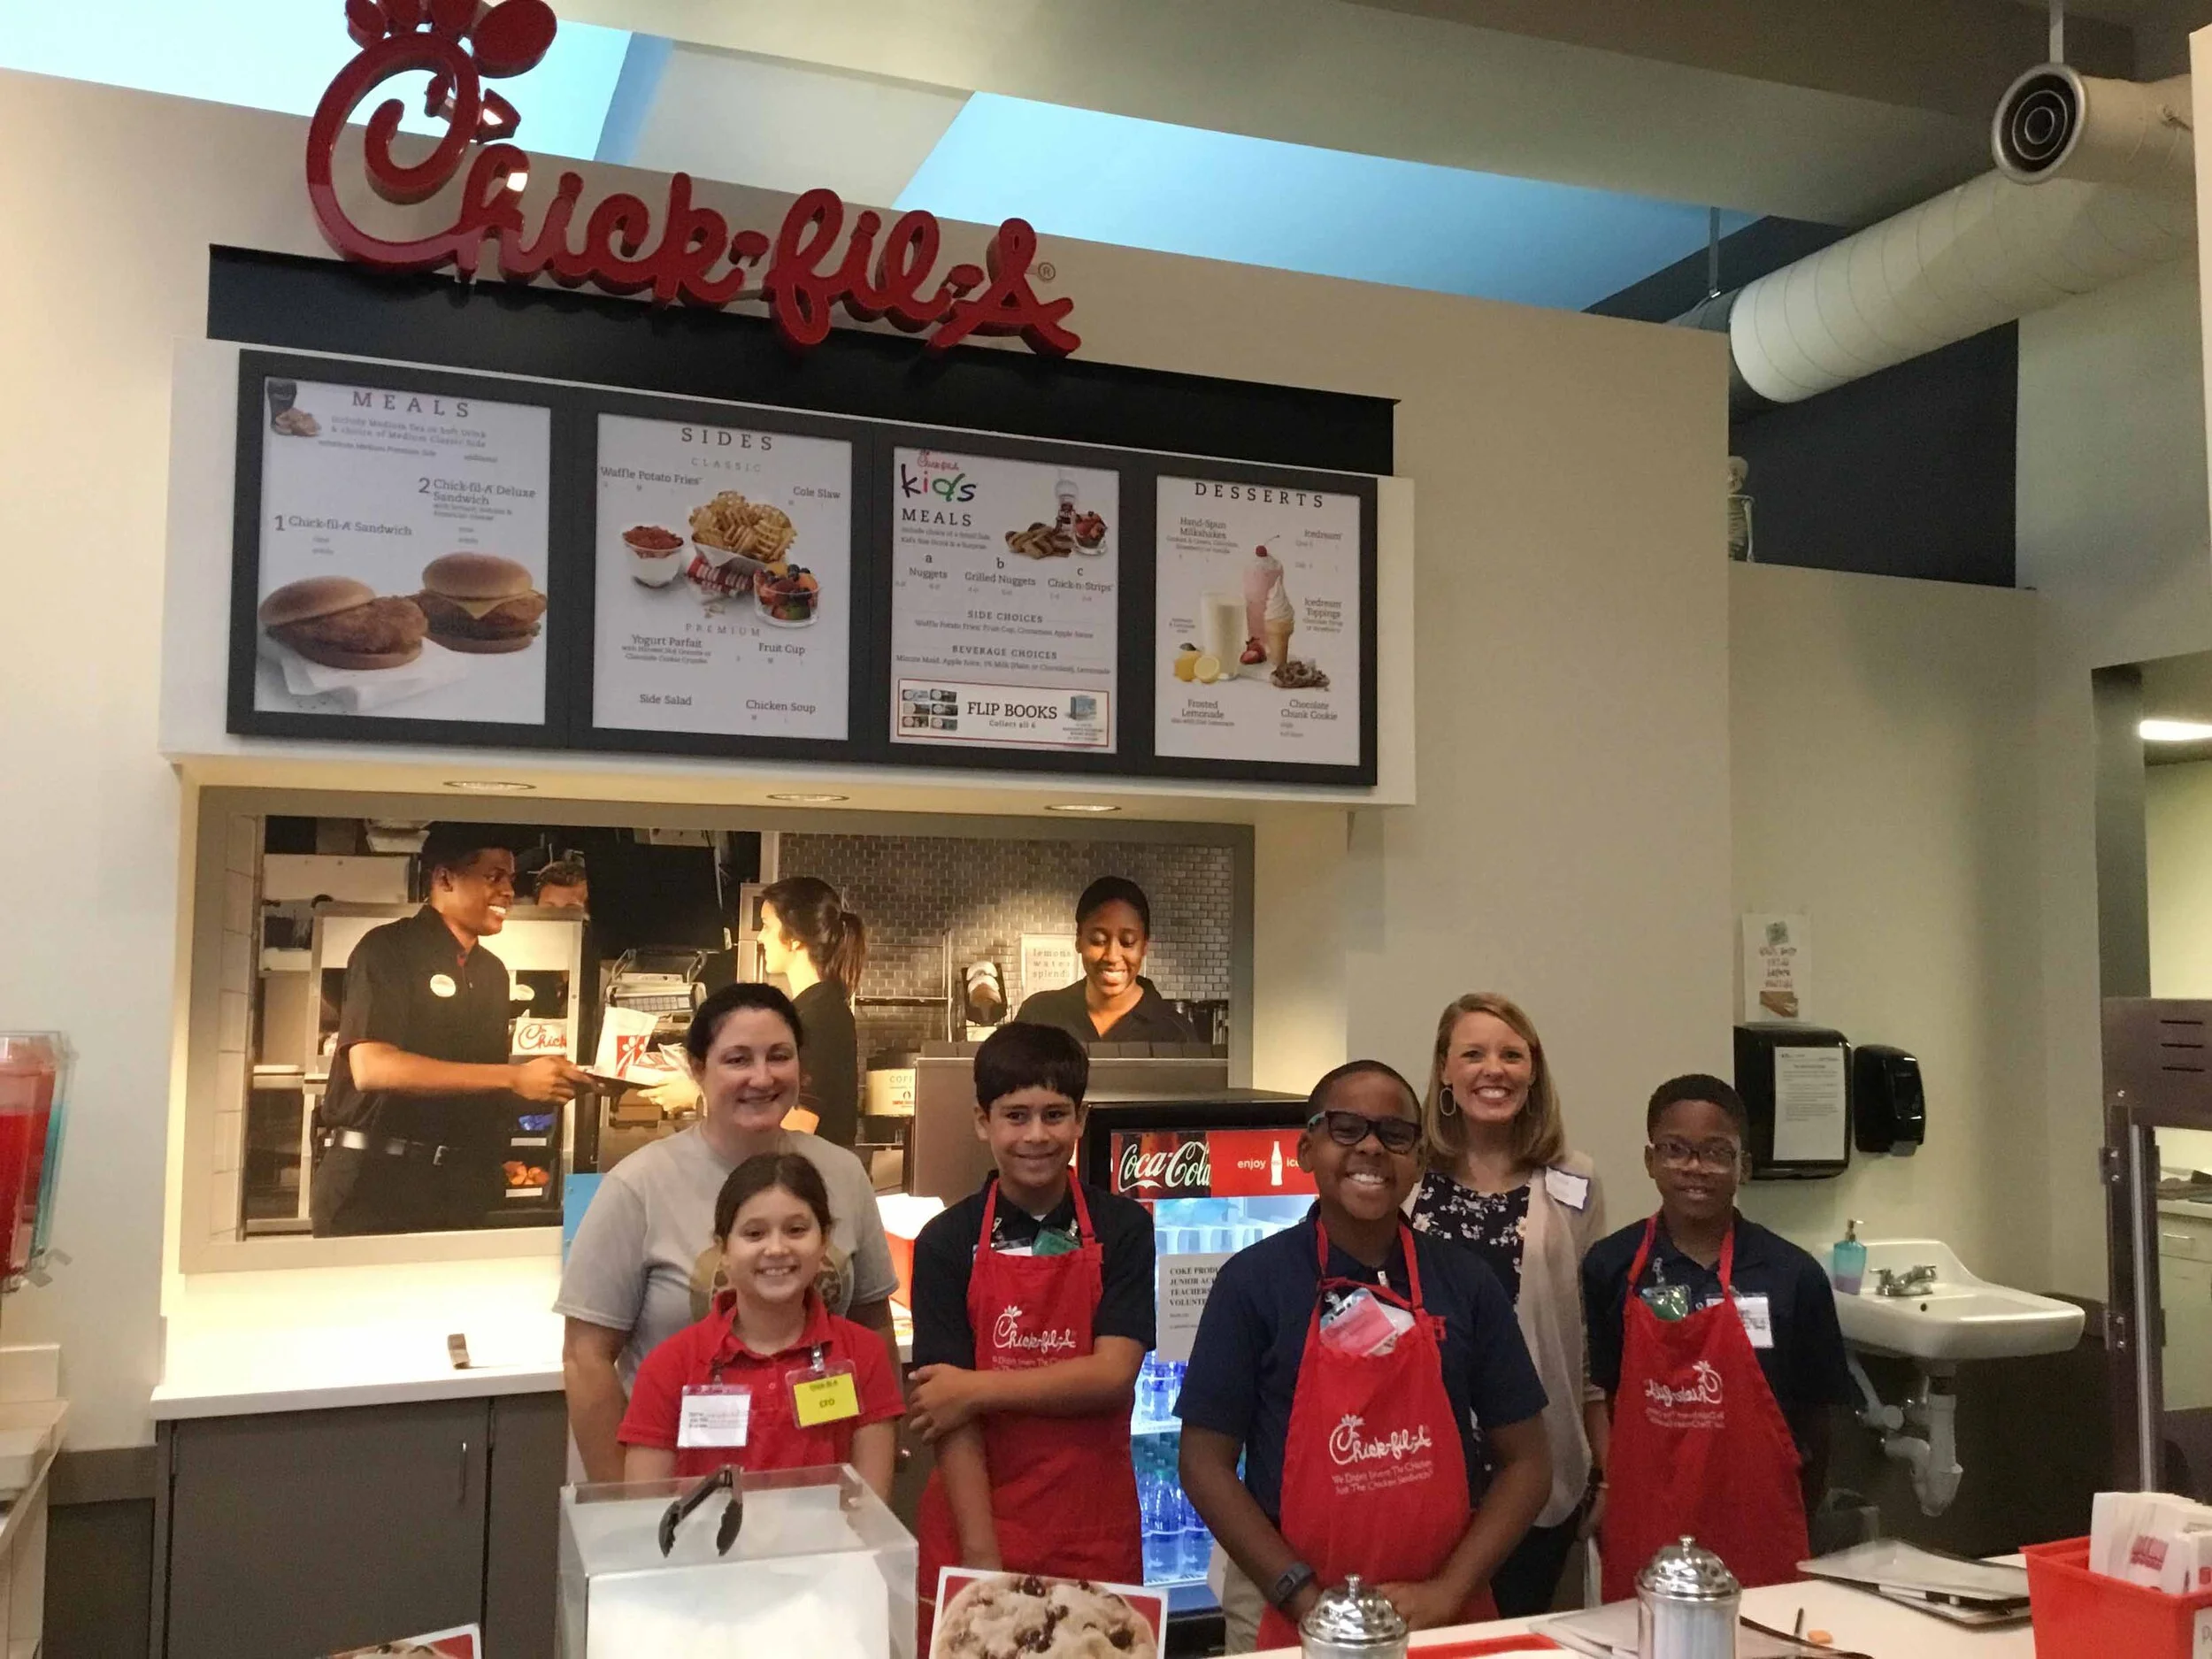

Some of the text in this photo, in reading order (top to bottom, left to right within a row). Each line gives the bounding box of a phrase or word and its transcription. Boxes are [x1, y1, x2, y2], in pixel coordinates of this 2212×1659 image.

[306, 0, 1080, 356] Chick-fil-A
[351, 390, 470, 419] MEALS
[681, 426, 773, 451] SIDES
[691, 457, 761, 472] CLASSIC
[601, 466, 636, 480] Waffle
[638, 469, 672, 483] Potato
[418, 477, 431, 494] 2
[901, 463, 977, 502] kids
[434, 491, 489, 505] Sandwich
[496, 485, 536, 498] Deluxe
[793, 487, 841, 499] Cole Slaw
[1194, 482, 1324, 508] DESSERTS
[274, 514, 285, 531] 1
[902, 508, 972, 526] MEALS
[1180, 517, 1226, 530] Hand-Spun
[355, 521, 411, 536] Sandwich
[1180, 527, 1226, 539] Milkshakes
[926, 554, 933, 564] a
[996, 557, 1005, 569] b
[909, 567, 948, 580] Nuggets
[1077, 567, 1083, 576] c
[964, 571, 1036, 587] Grilled Nuggets
[967, 610, 1043, 623] SIDE CHOICES
[686, 623, 760, 636] PREMIUM
[631, 634, 703, 648] Yogurt Parfait
[758, 641, 806, 657] Fruit Cup
[952, 645, 1057, 659] BEVERAGE CHOICES
[640, 694, 692, 706] Side Salad
[746, 699, 816, 714] Chicken Soup
[1187, 698, 1218, 709] Frosted
[1289, 699, 1329, 710] Chocolate
[967, 702, 1057, 719] FLIP BOOKS
[1181, 708, 1225, 719] Lemonade
[1280, 708, 1338, 720] Chunk Cookie
[988, 718, 1017, 728] Collect
[1018, 719, 1029, 728] all
[1118, 1141, 1211, 1192] Coca-Cola
[1238, 1159, 1266, 1170] enjoy
[1329, 1414, 1432, 1465] Chick-fil-A
